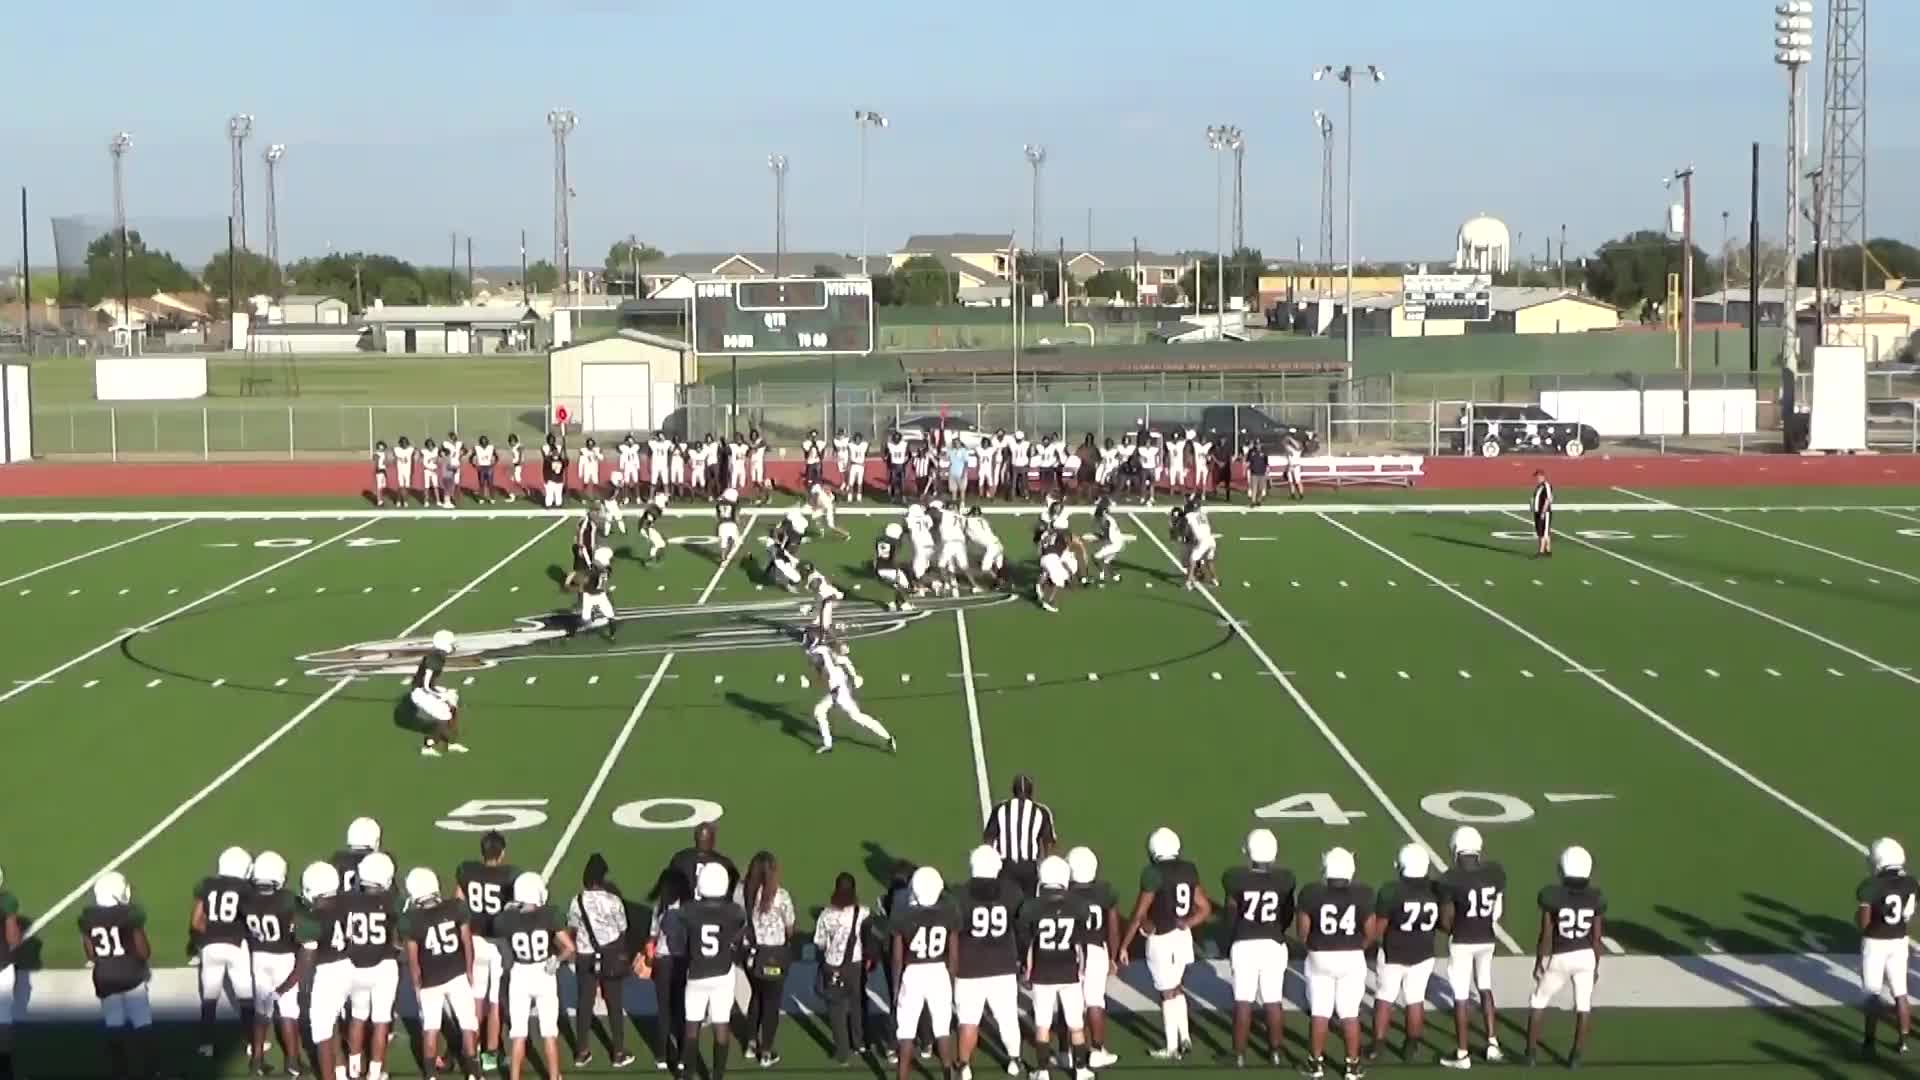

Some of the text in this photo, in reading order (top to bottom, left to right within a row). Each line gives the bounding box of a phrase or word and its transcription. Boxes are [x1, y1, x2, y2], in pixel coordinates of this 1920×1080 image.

[208, 890, 239, 922] 18
[467, 881, 500, 914] 85
[1176, 883, 1190, 916] 9
[1243, 891, 1278, 922] 72
[1466, 886, 1496, 918] 15
[352, 912, 387, 945] 35
[971, 906, 1008, 937] 99
[1320, 904, 1356, 935] 64
[1400, 902, 1438, 932] 73
[1558, 908, 1594, 939] 25
[91, 926, 125, 957] 31
[425, 921, 459, 956] 45
[701, 924, 721, 957] 5
[909, 926, 947, 960] 48
[1038, 918, 1075, 950] 27
